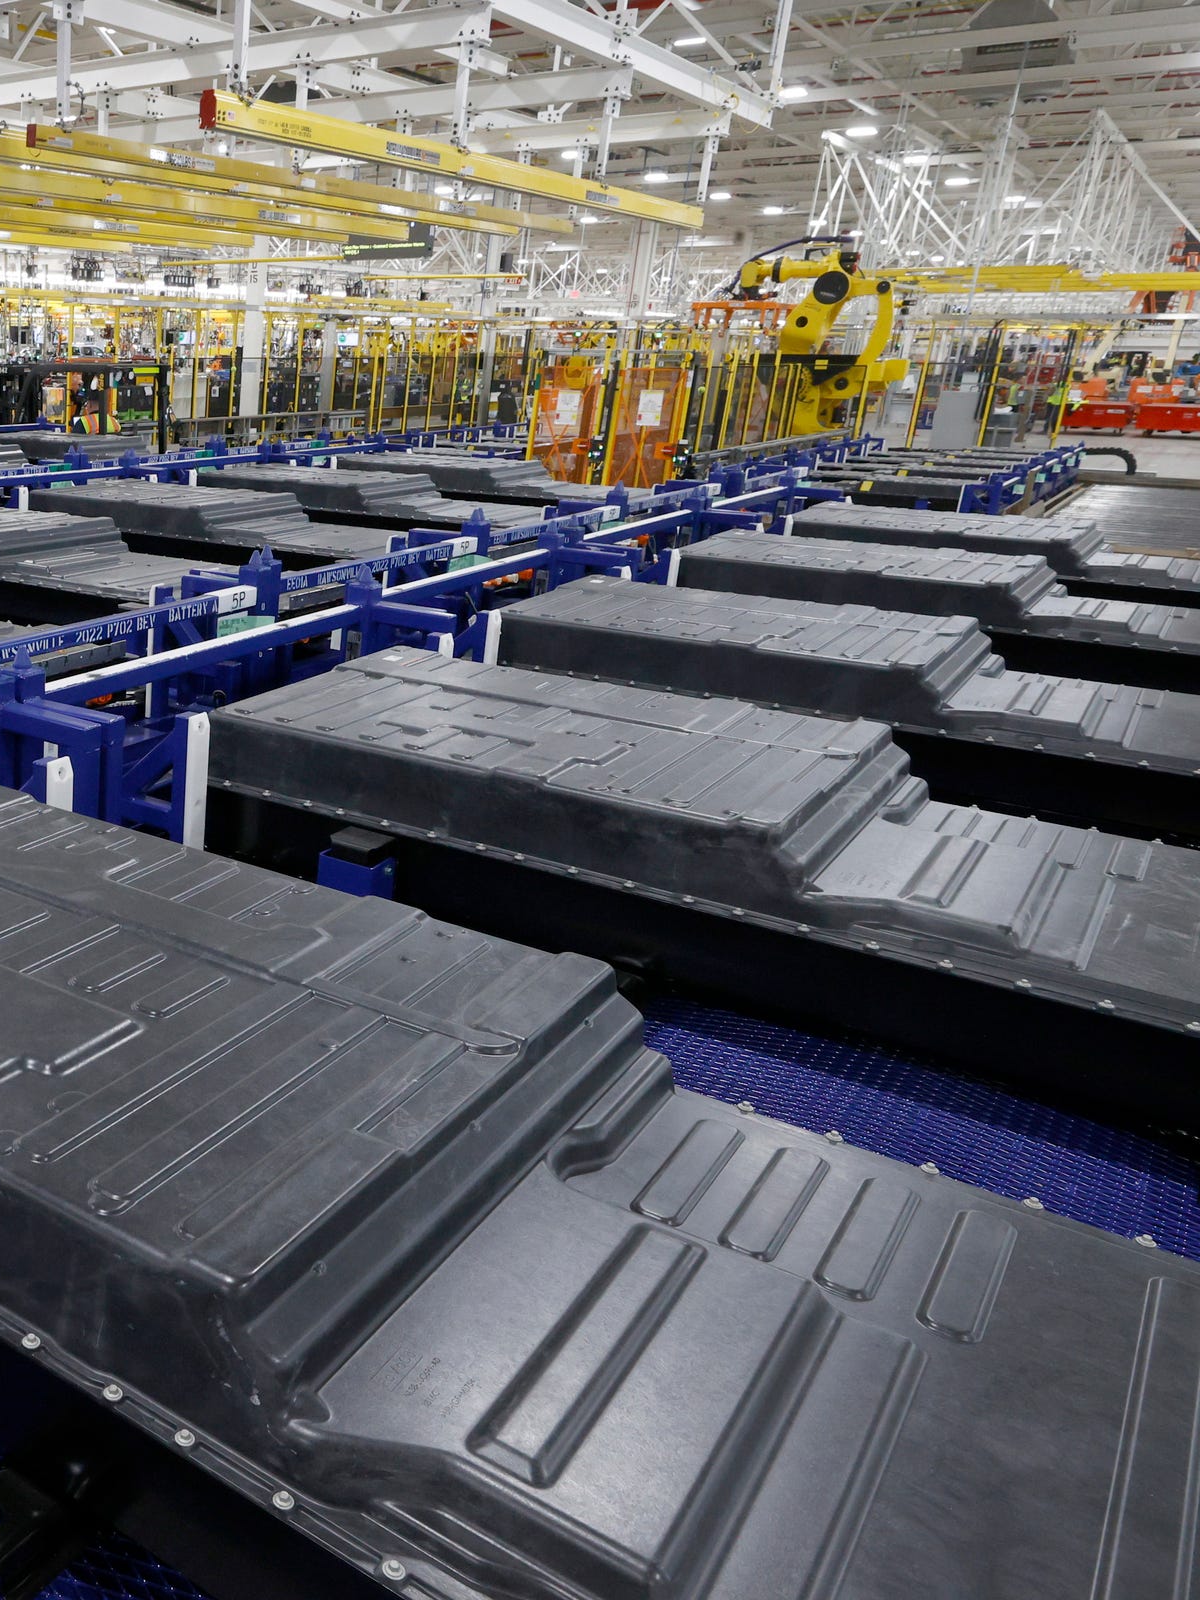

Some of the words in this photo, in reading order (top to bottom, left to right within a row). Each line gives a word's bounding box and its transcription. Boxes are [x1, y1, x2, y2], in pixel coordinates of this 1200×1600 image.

[317, 564, 360, 585] RAWSONVILL
[371, 559, 390, 573] 2022
[390, 555, 406, 569] P702
[408, 551, 421, 565] BEV
[231, 591, 246, 610] 5P
[75, 625, 103, 644] 2022
[107, 618, 133, 639] P702
[136, 613, 157, 631] BEV
[168, 601, 209, 623] BATTERY
